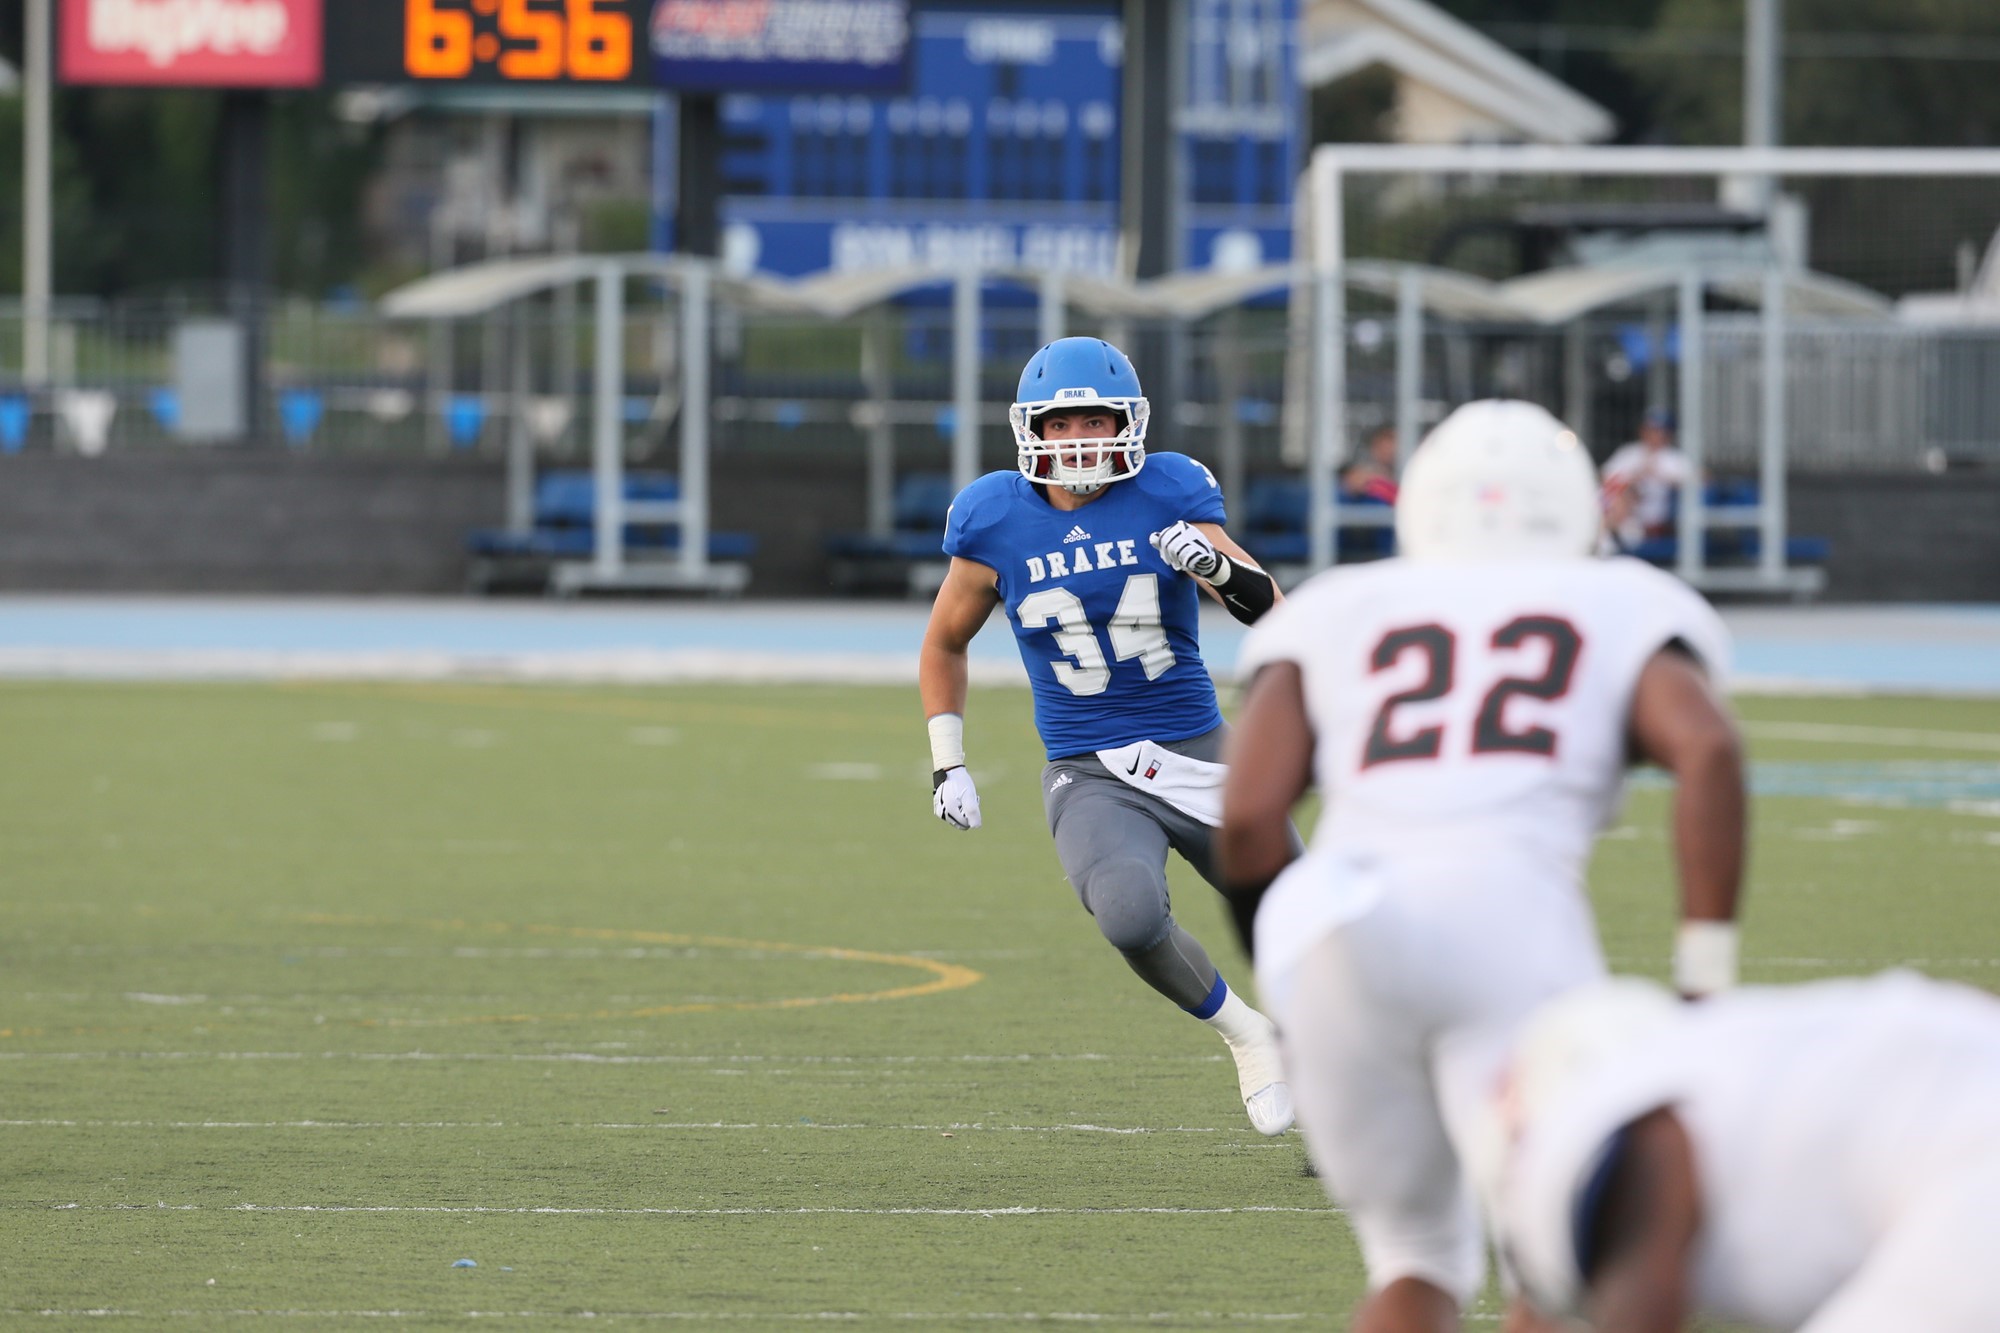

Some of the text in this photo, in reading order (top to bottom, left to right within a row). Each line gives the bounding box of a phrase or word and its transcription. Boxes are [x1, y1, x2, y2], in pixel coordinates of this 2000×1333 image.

[404, 0, 633, 79] 6:56
[1064, 389, 1086, 398] DRAKE
[1025, 539, 1139, 583] DRAKE
[1063, 533, 1091, 544] adidas
[1016, 573, 1177, 696] 34
[1360, 614, 1583, 771] 22
